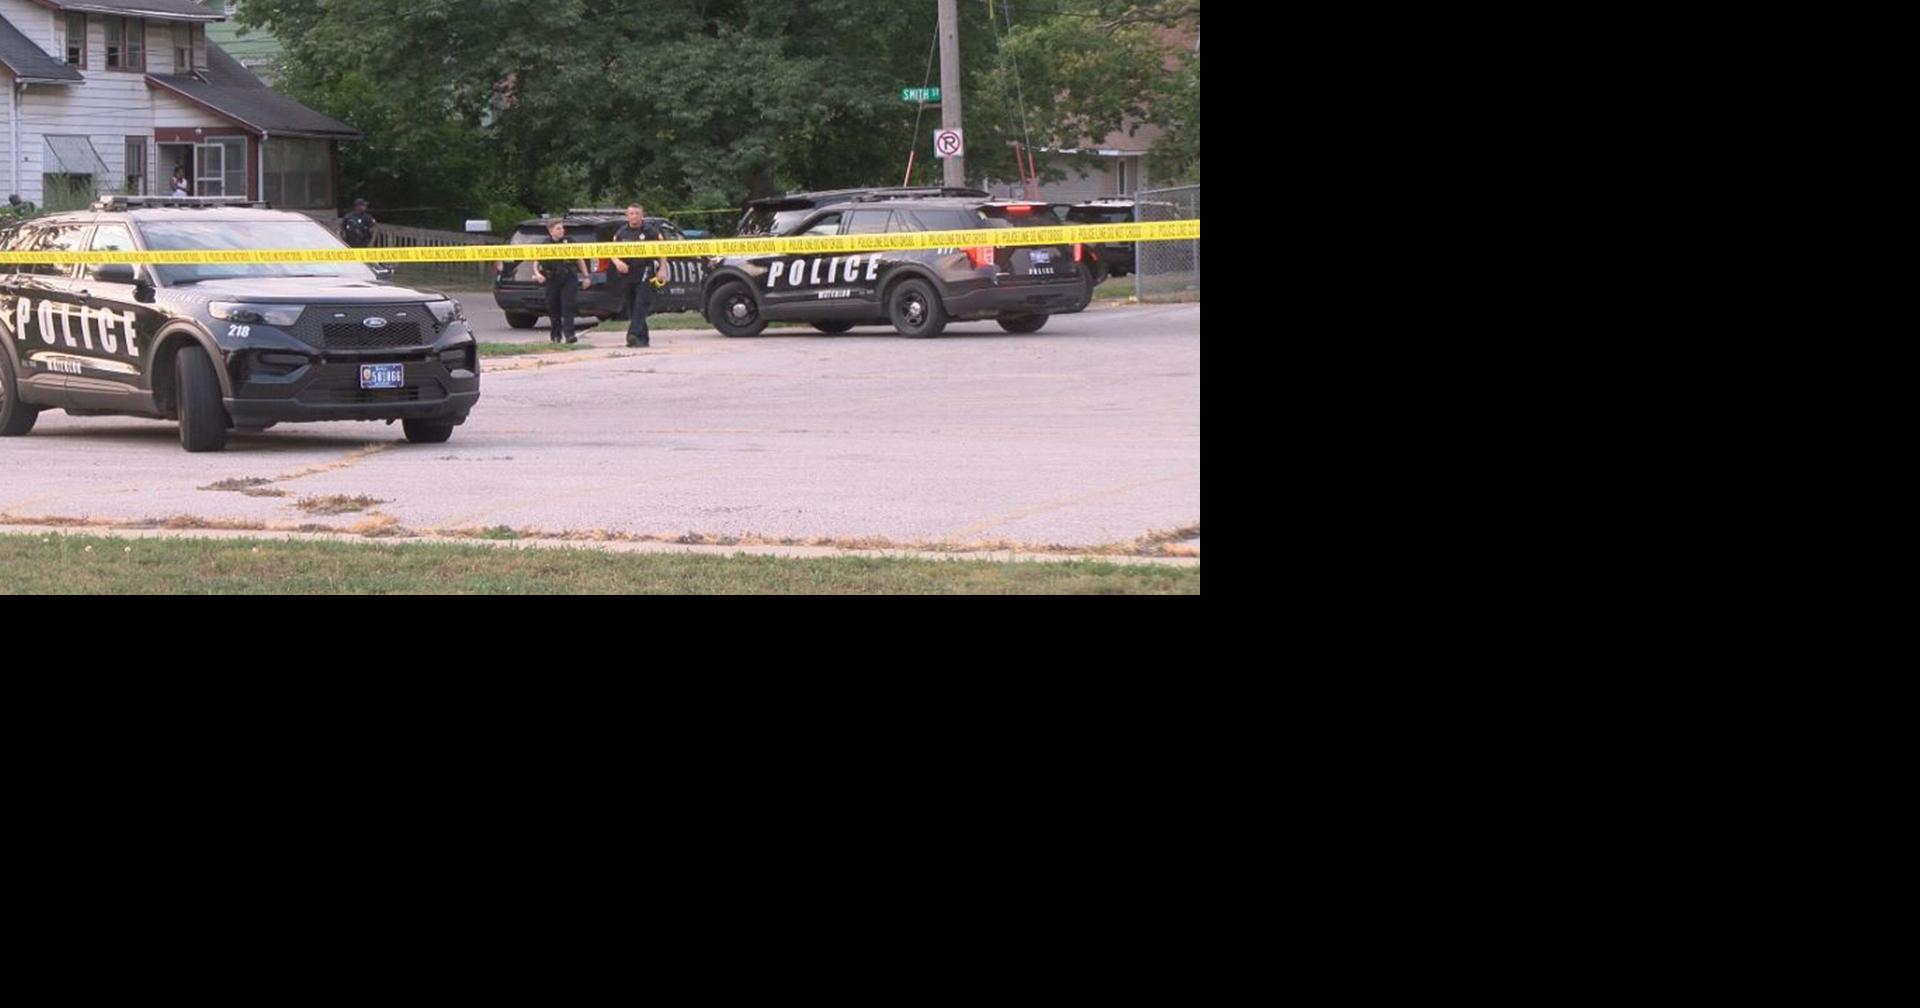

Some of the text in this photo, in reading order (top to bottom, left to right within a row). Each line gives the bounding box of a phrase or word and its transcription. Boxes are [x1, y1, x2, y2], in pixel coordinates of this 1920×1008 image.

[903, 87, 929, 101] SMITH
[766, 254, 882, 287] POLICE
[16, 296, 140, 357] POLICE
[228, 324, 251, 338] 218
